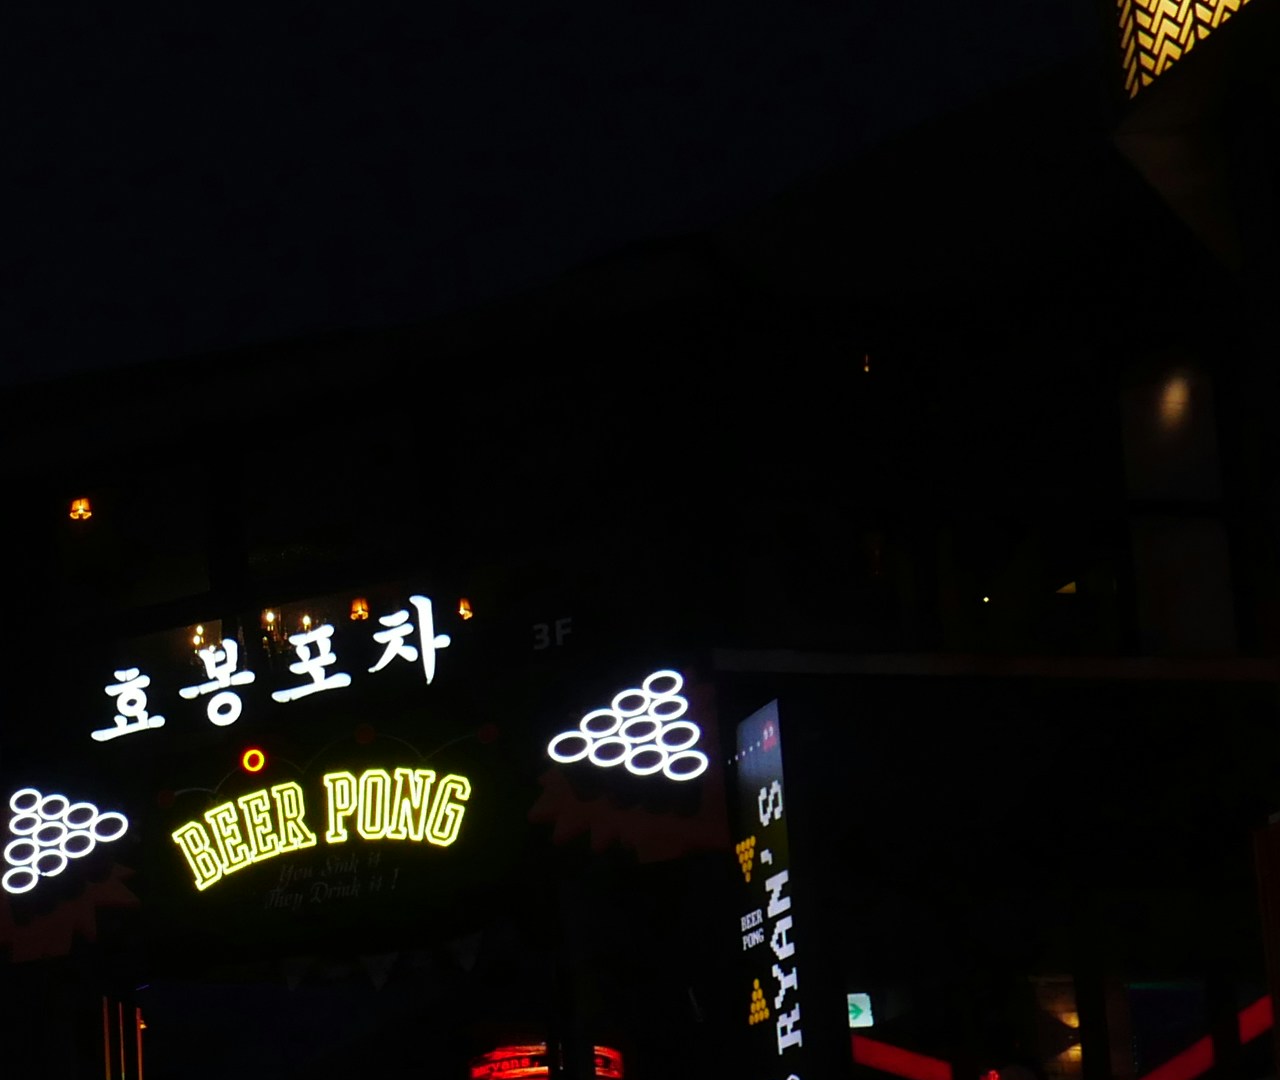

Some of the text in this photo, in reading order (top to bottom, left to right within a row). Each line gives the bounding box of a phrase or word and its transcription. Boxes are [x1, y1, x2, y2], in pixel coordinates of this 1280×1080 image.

[90, 595, 452, 742] 효봉포차
[532, 616, 574, 651] 3F
[172, 768, 472, 892] BEER PONG
[740, 908, 764, 932] BEER
[742, 928, 765, 951] PONG
[758, 780, 803, 1056] RYAN'S
